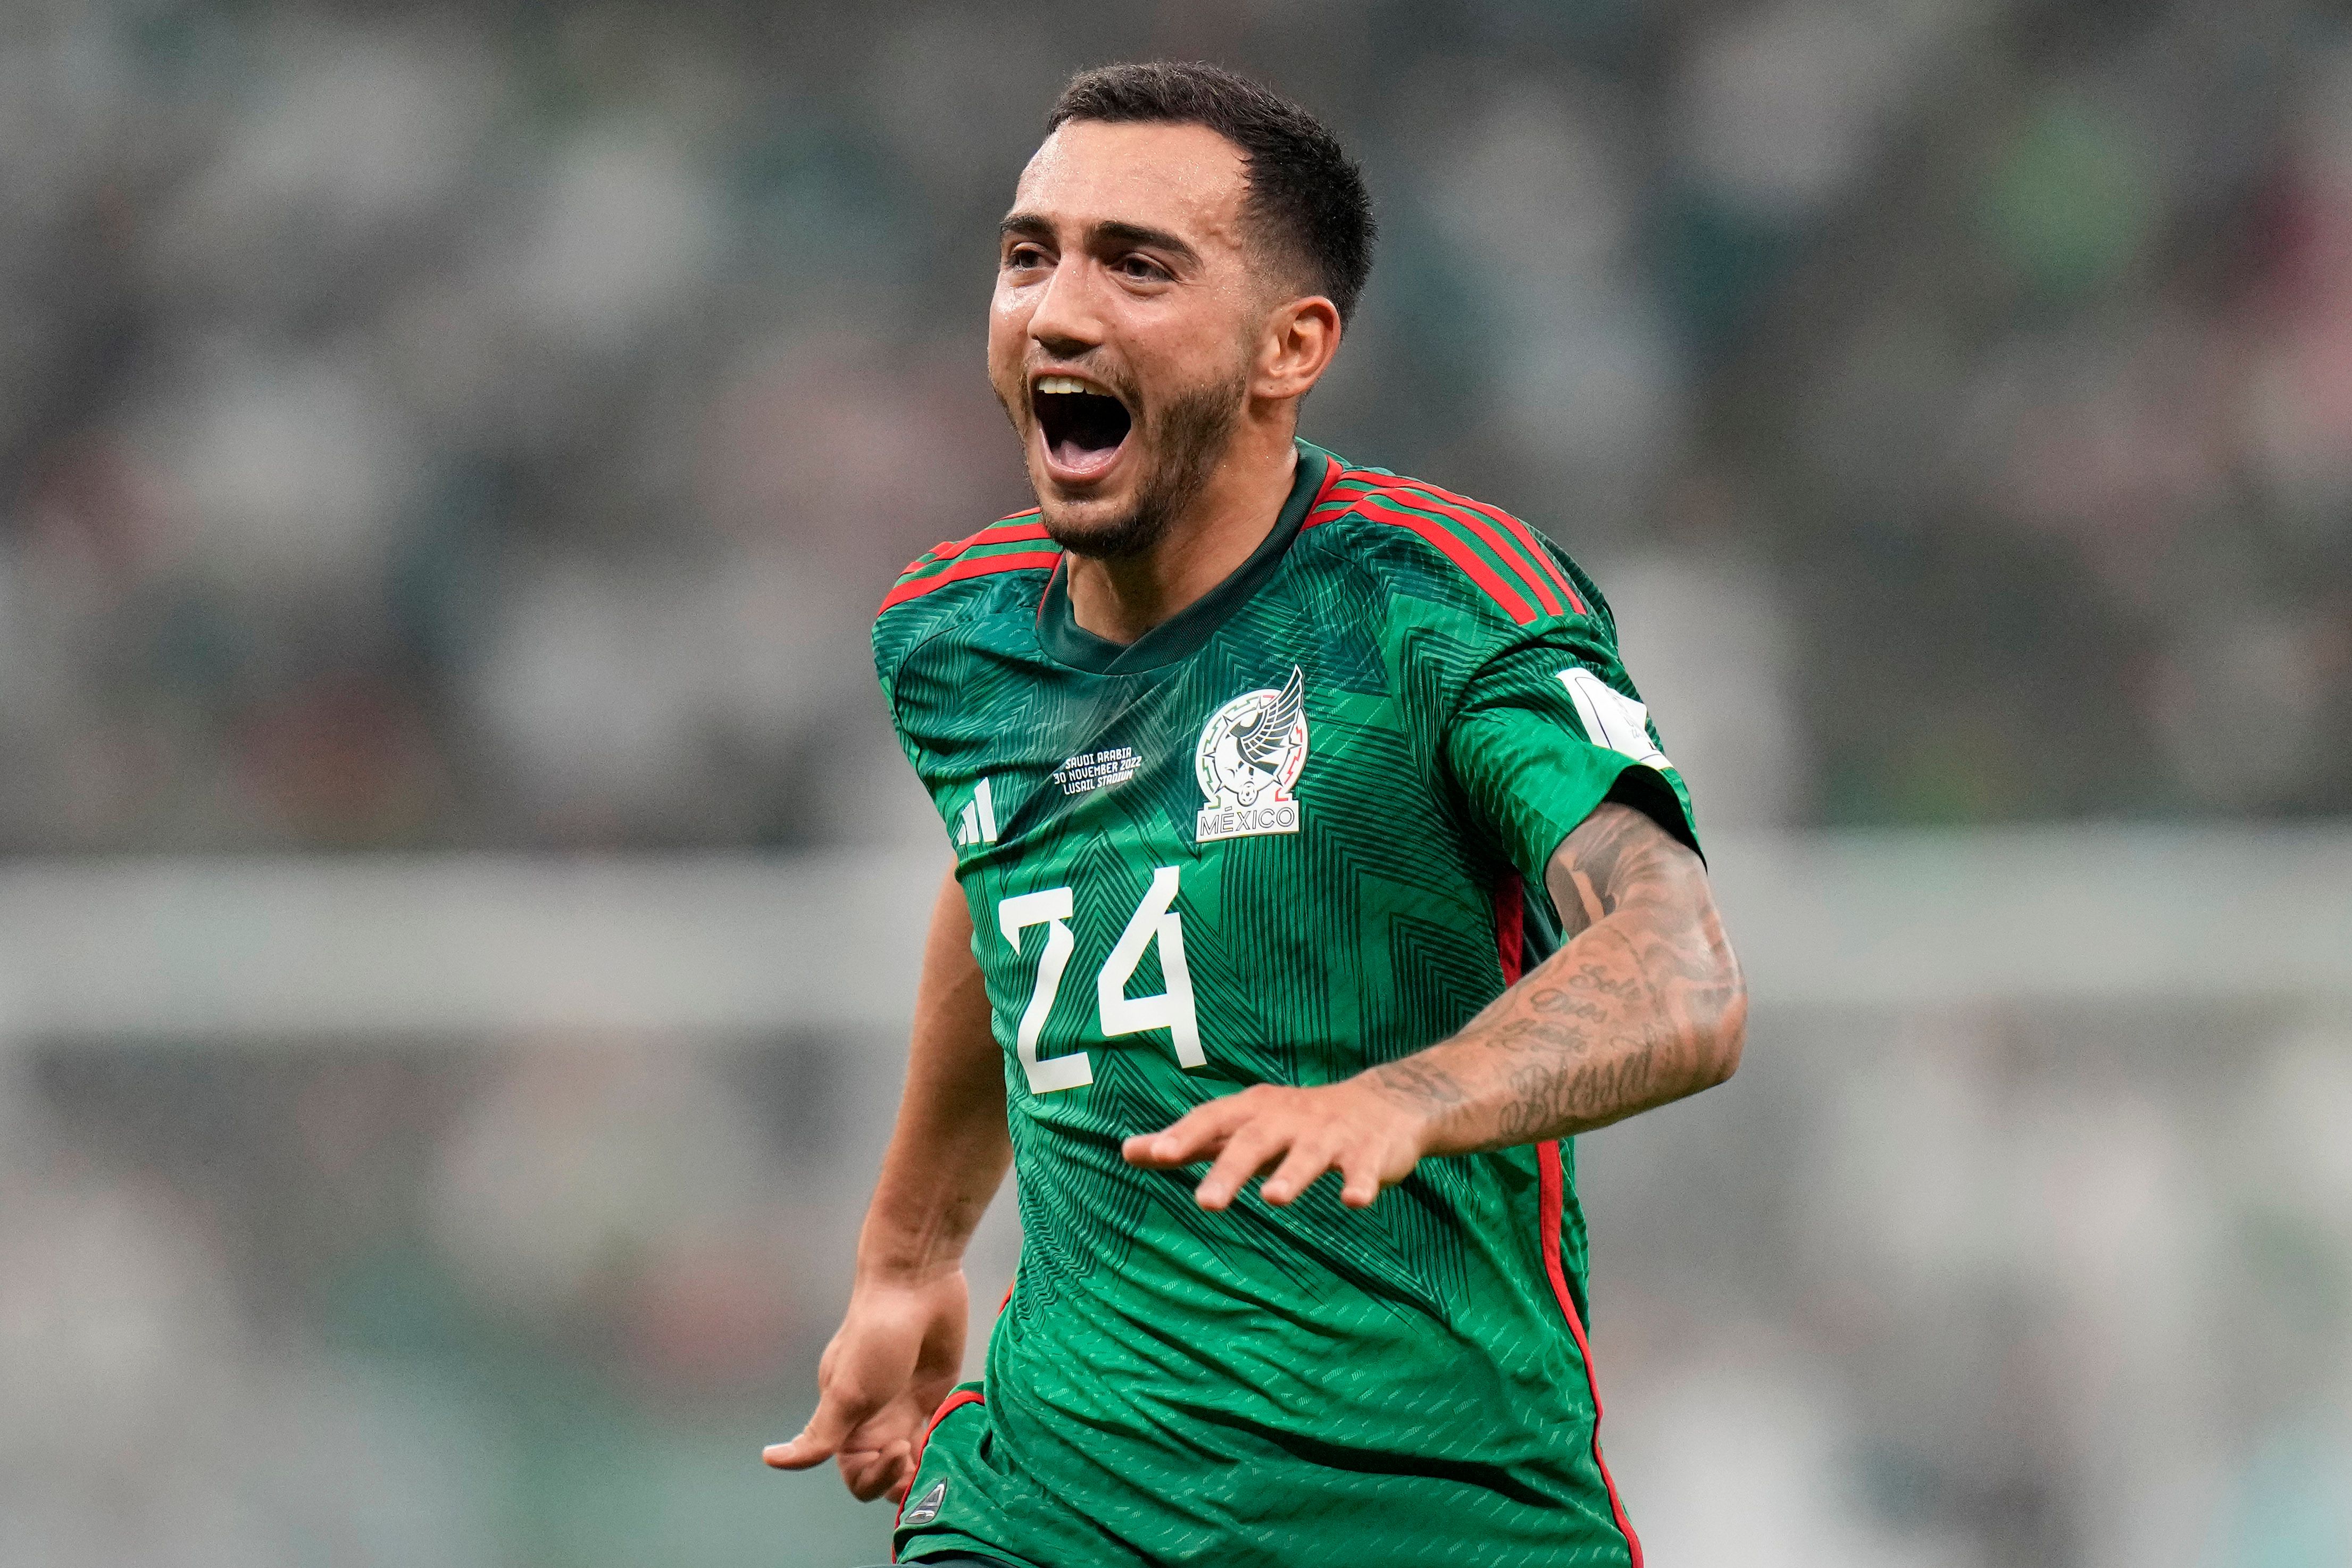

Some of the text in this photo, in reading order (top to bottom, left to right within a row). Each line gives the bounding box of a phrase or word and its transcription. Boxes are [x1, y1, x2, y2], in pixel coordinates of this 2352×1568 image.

[1053, 756, 1142, 785] 30 NOVEMBER 2022
[1065, 747, 1132, 769] SAUDI ARABIA
[1063, 769, 1133, 795] LUSAIL STADIUM
[1200, 806, 1295, 836] MÉXICO
[998, 865, 1207, 1095] 24
